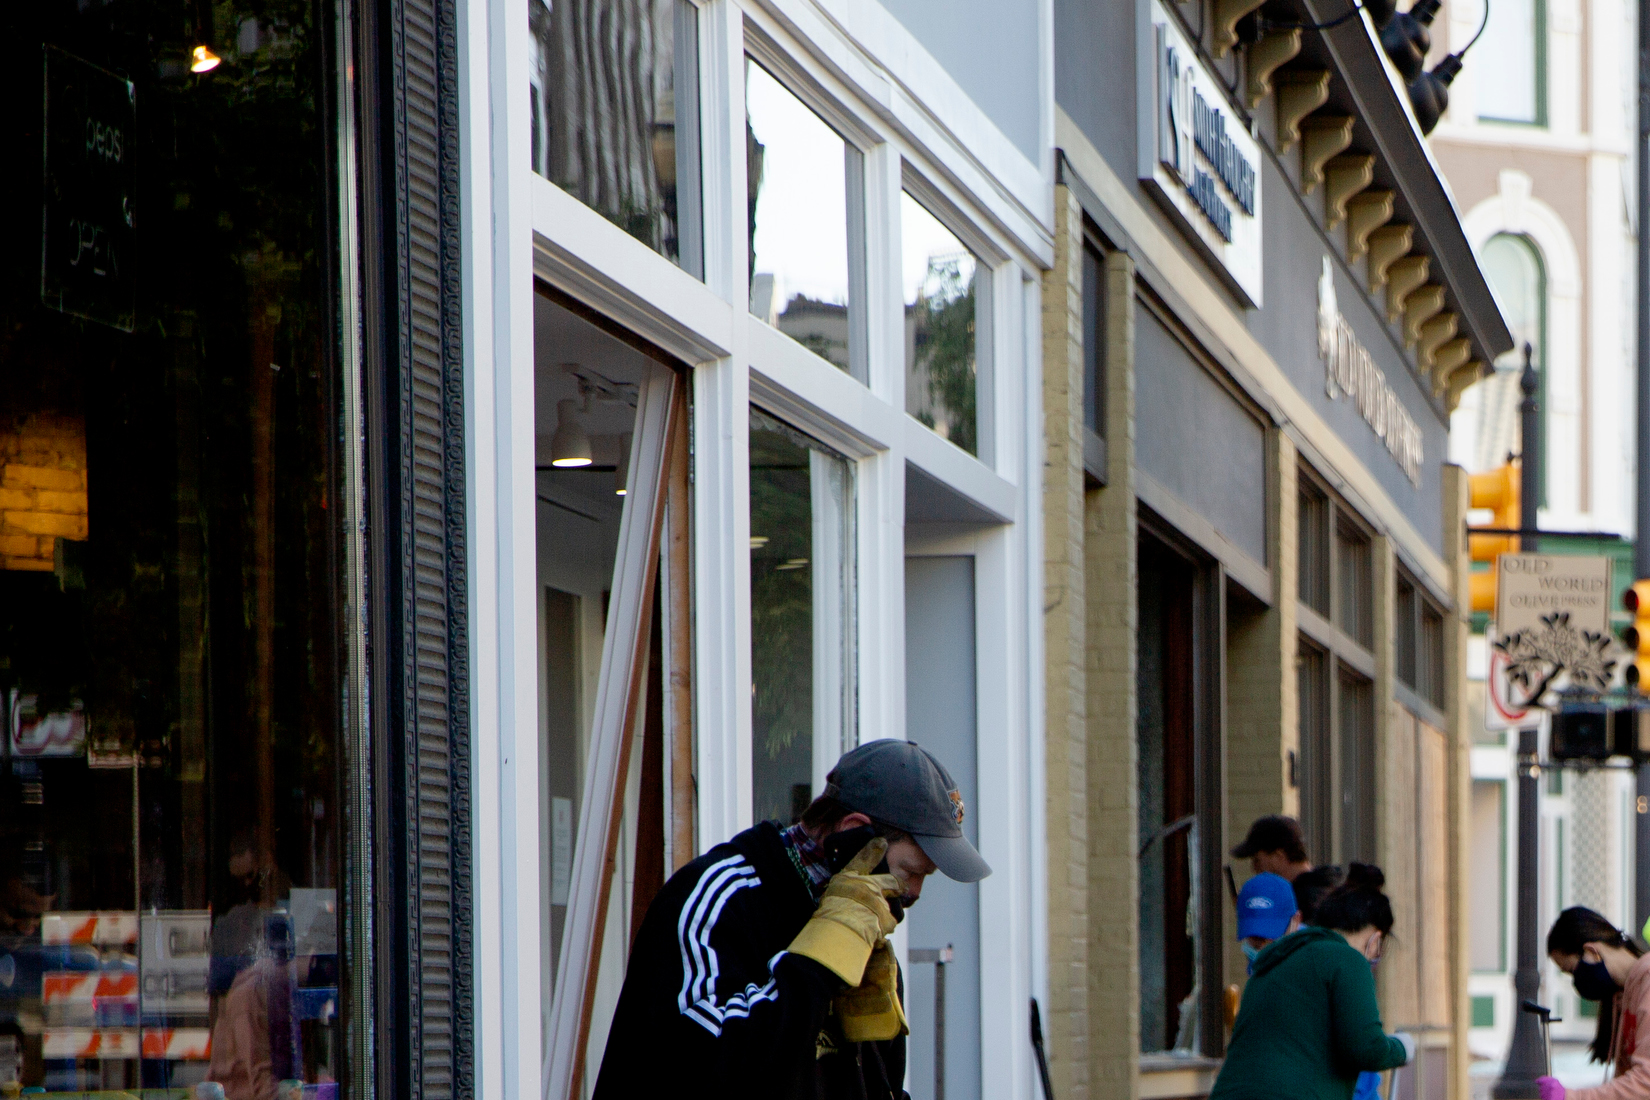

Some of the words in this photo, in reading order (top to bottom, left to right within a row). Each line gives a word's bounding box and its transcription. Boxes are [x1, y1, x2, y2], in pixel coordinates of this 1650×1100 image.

[1504, 558, 1549, 574] OLD
[1538, 575, 1603, 592] WORLD
[1509, 593, 1557, 609] OLIVE
[1561, 595, 1597, 607] PRESS
